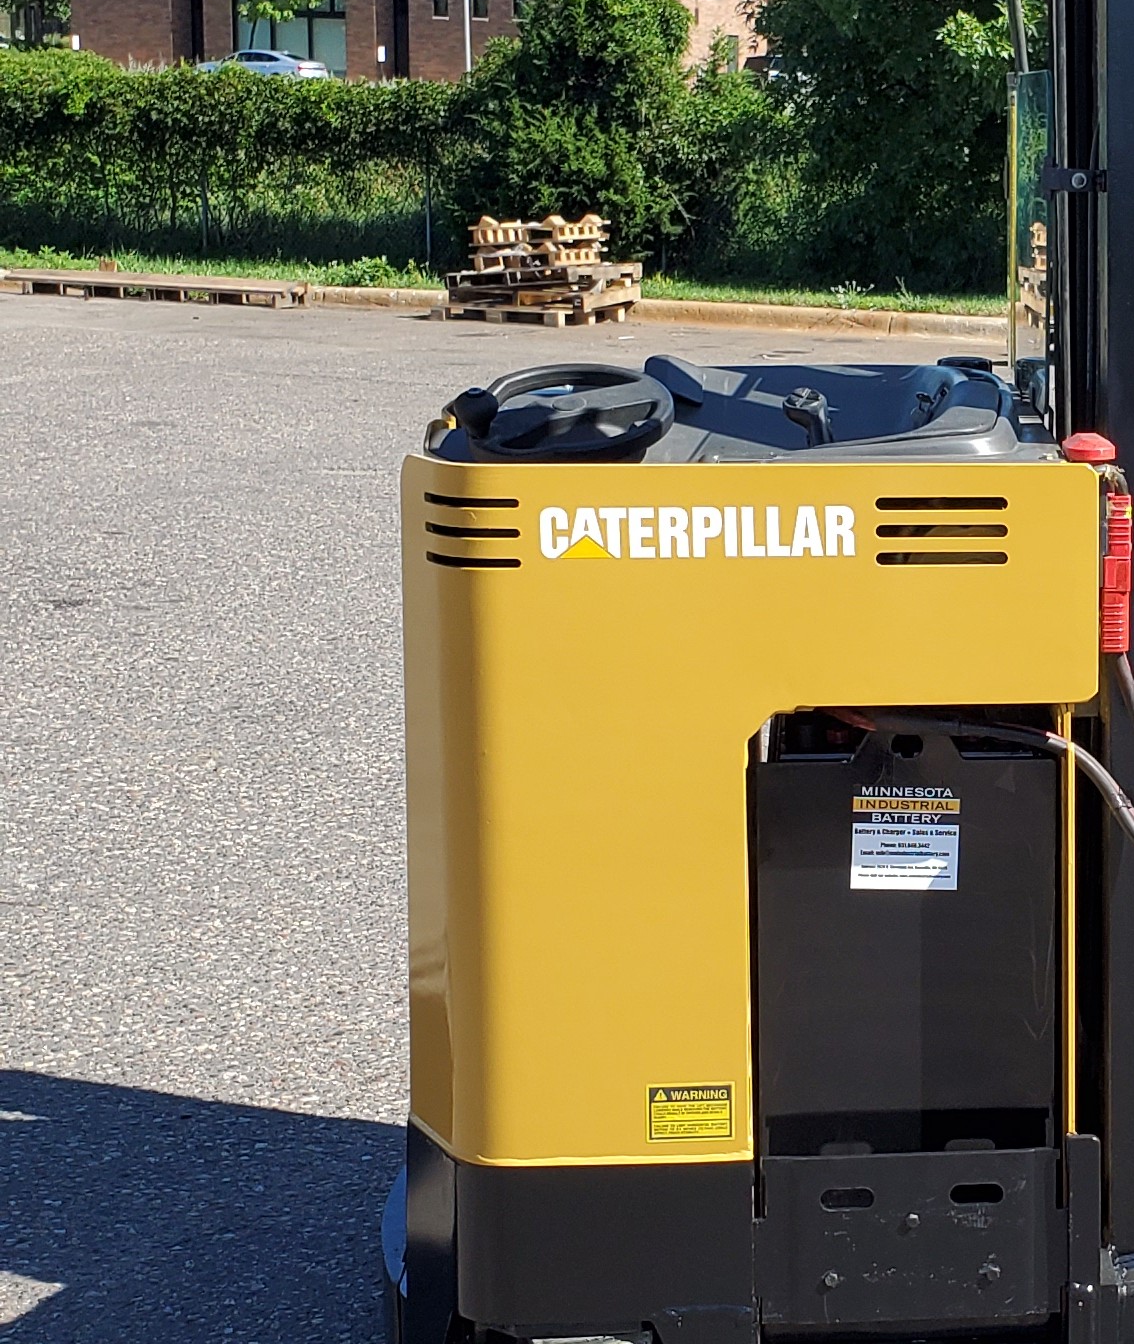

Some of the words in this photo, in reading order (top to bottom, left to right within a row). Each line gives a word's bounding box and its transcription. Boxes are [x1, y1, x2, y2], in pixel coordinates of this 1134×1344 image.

[539, 505, 856, 560] CATERPILLAR
[861, 786, 954, 798] MINNESOTA
[859, 799, 955, 811] INDUSTRIAL
[871, 812, 943, 824] BATTERY
[854, 828, 876, 836] Battery
[882, 828, 906, 836] Charger
[670, 1089, 728, 1101] WARNING
